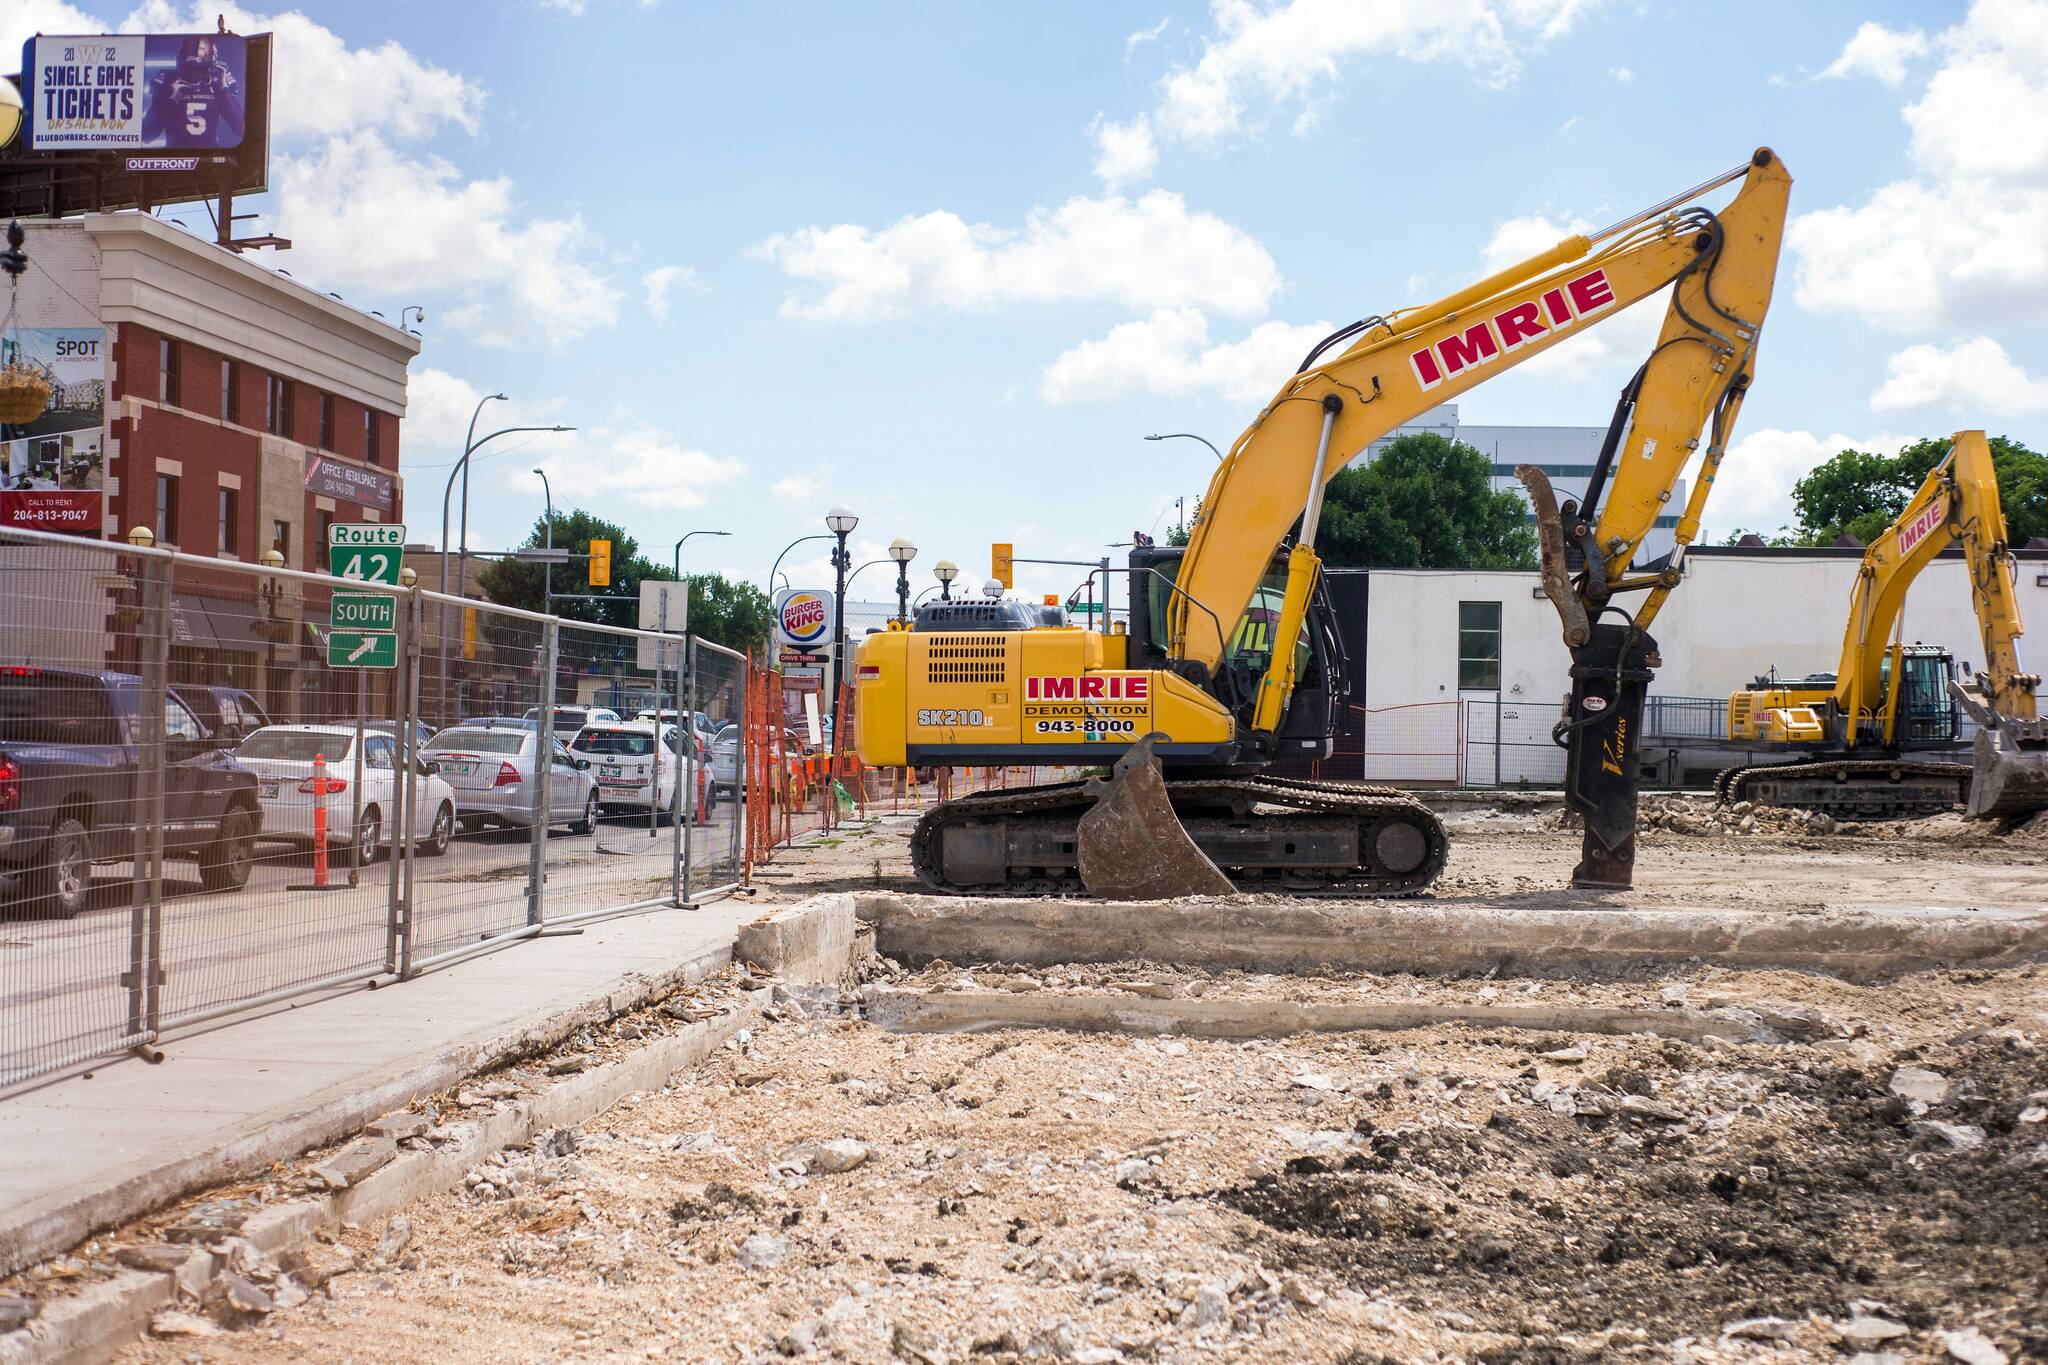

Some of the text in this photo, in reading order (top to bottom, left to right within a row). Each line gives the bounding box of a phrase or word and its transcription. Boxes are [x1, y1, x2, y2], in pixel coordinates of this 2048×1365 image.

[65, 47, 75, 61] 20
[105, 47, 116, 61] 22
[44, 66, 135, 86] SINGLE GAME
[44, 88, 134, 120] TICKETS
[100, 118, 127, 130] NOW
[186, 103, 207, 135] 5
[36, 134, 139, 142] BLUEBOMBERS.COM/TICKETS
[128, 160, 195, 169] OUTFRONT
[1410, 268, 1616, 391] IMRIE
[56, 340, 99, 355] SPOT
[321, 462, 341, 479] OFFICE
[13, 510, 88, 520] 204-813-9047
[336, 527, 399, 542] Route
[1899, 502, 1941, 556] IMRIE
[342, 554, 388, 585] 42
[336, 604, 389, 621] SOUTH
[784, 600, 822, 619] BURGER
[786, 610, 824, 632] KING
[1025, 676, 1149, 701] IMRIE
[1025, 705, 1148, 716] DEMOLITION
[1753, 712, 1772, 722] IMRIE
[1036, 720, 1136, 734] 943-8000
[1602, 717, 1627, 776] V series
